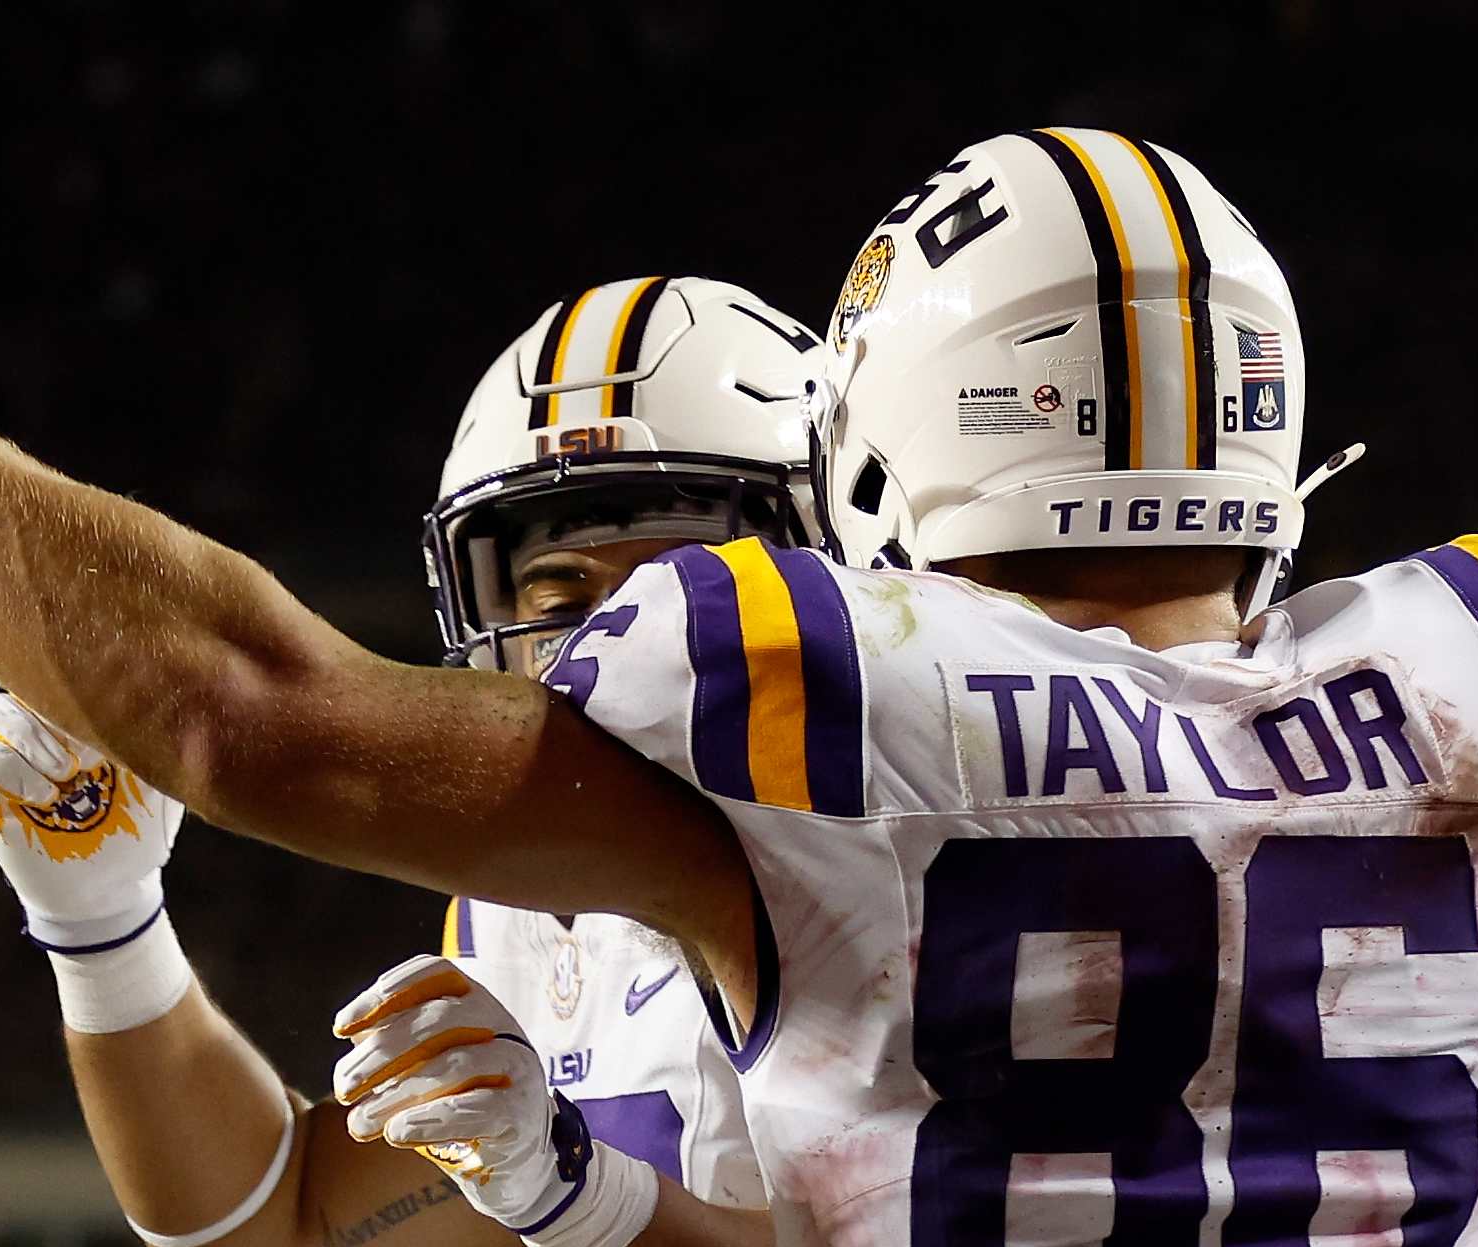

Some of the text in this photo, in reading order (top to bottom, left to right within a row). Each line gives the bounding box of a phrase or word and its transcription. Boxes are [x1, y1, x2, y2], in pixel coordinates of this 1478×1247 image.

[970, 387, 1019, 398] DANGER
[1077, 398, 1098, 436] 8
[1223, 395, 1238, 433] 6
[536, 426, 618, 462] LSU
[1049, 499, 1279, 535] TIGERS
[964, 668, 1430, 801] TAYLOR
[548, 1048, 593, 1087] LSU
